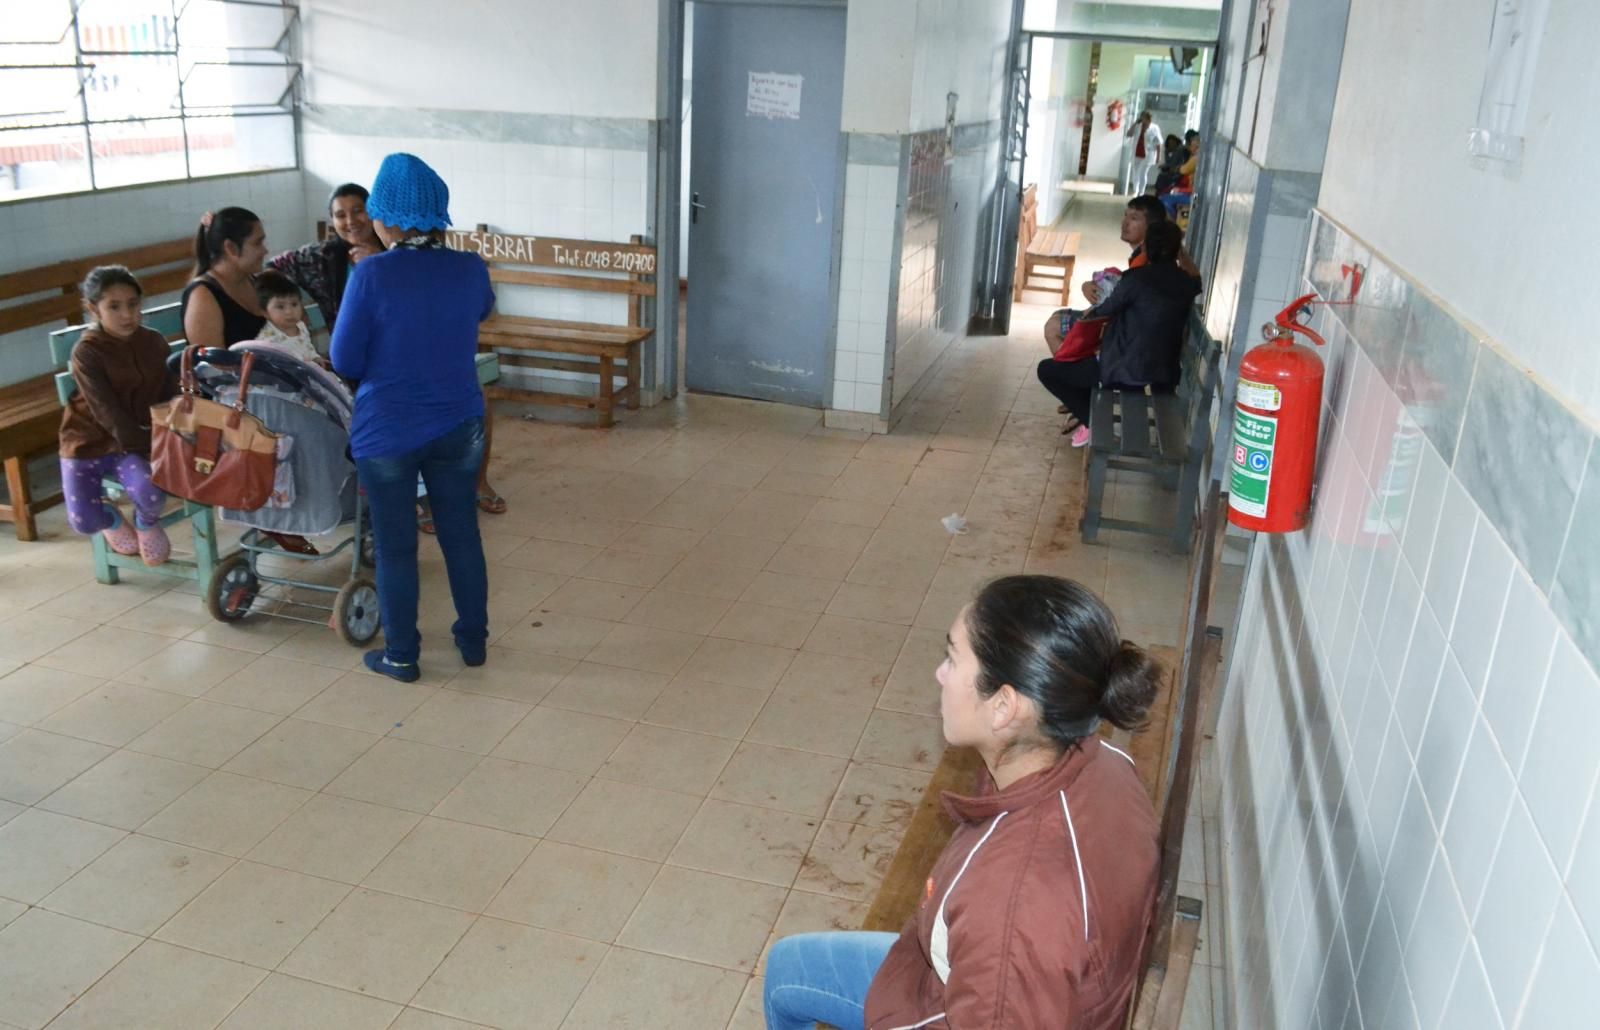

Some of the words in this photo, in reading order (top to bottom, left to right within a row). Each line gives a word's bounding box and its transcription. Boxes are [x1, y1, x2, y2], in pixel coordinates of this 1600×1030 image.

[445, 232, 536, 263] NTSERRAT
[613, 251, 656, 271] 210700
[1247, 420, 1272, 433] Fire
[1236, 447, 1245, 464] B
[1252, 454, 1265, 469] C
